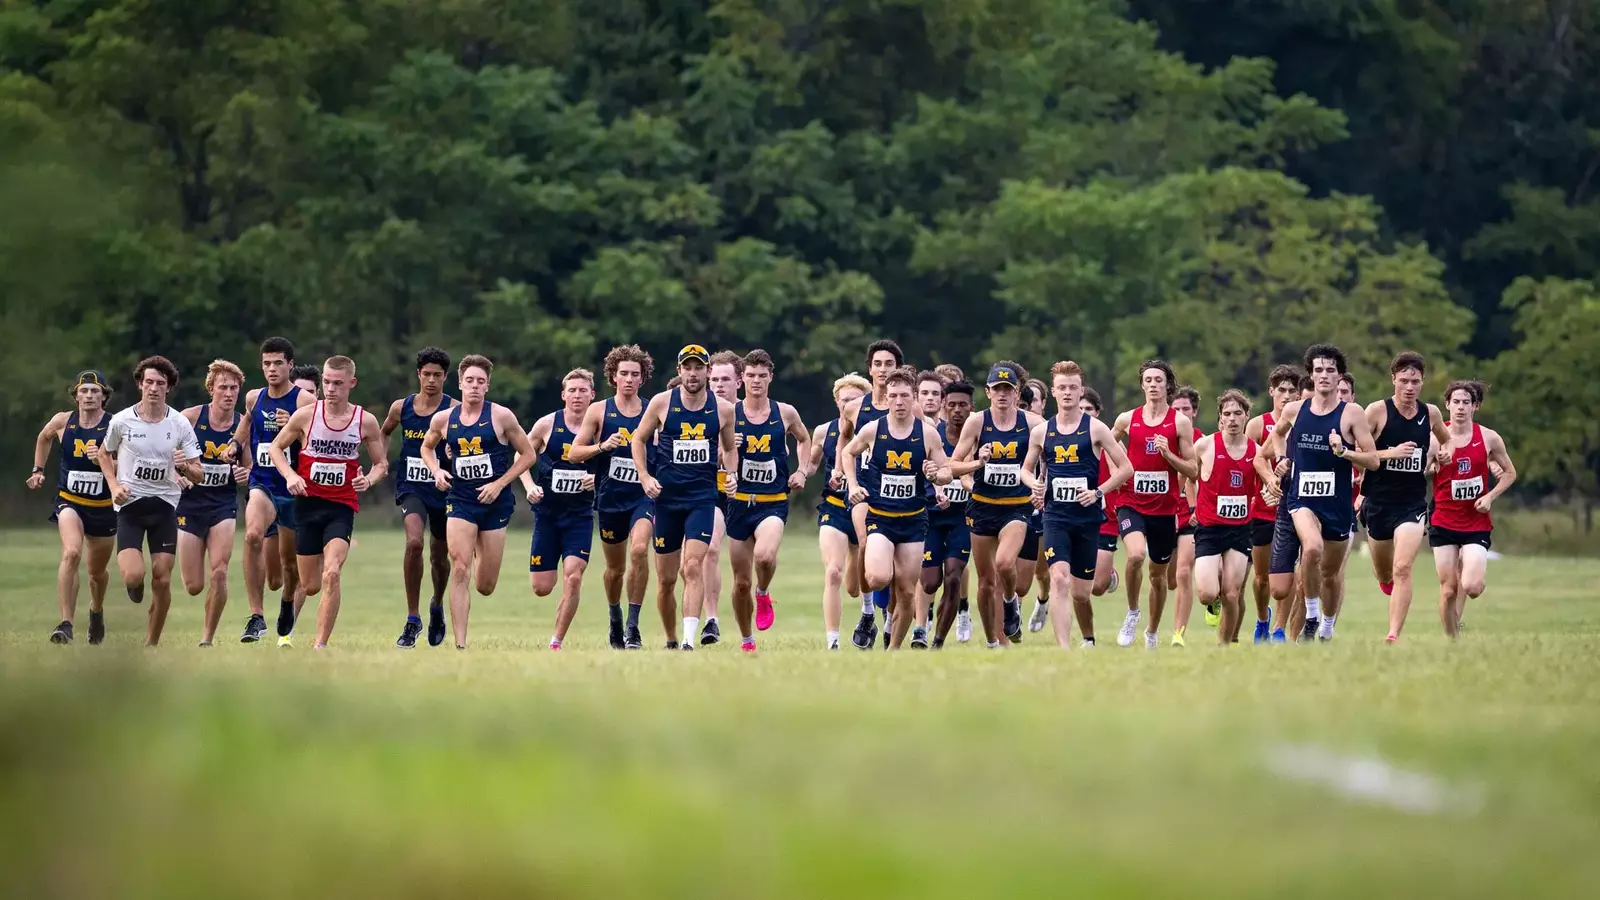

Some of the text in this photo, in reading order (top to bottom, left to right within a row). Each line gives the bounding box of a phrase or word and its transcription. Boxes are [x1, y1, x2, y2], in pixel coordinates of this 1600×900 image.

[998, 371, 1009, 379] M
[680, 422, 706, 440] M
[1301, 433, 1323, 443] SJP
[73, 438, 97, 458] M
[203, 440, 230, 459] M
[311, 439, 358, 451] PINCKNEY
[457, 436, 483, 456] M
[746, 434, 771, 453] M
[991, 441, 1018, 459] M
[676, 448, 707, 463] 4780
[886, 450, 912, 470] M
[1054, 444, 1079, 464] M
[459, 463, 490, 479] 4782
[1388, 457, 1420, 471] 4805
[134, 466, 166, 481] 4801
[312, 471, 344, 485] 4796
[745, 468, 773, 481] 4774
[988, 472, 1017, 486] 4773
[71, 480, 99, 494] 4777
[555, 478, 583, 492] 4772
[883, 484, 914, 498] 4769
[1136, 479, 1167, 493] 4738
[1302, 481, 1332, 495] 4797
[1056, 487, 1080, 501] 477
[1454, 485, 1481, 500] 4742
[1219, 504, 1246, 518] 4736
[530, 555, 541, 566] M
